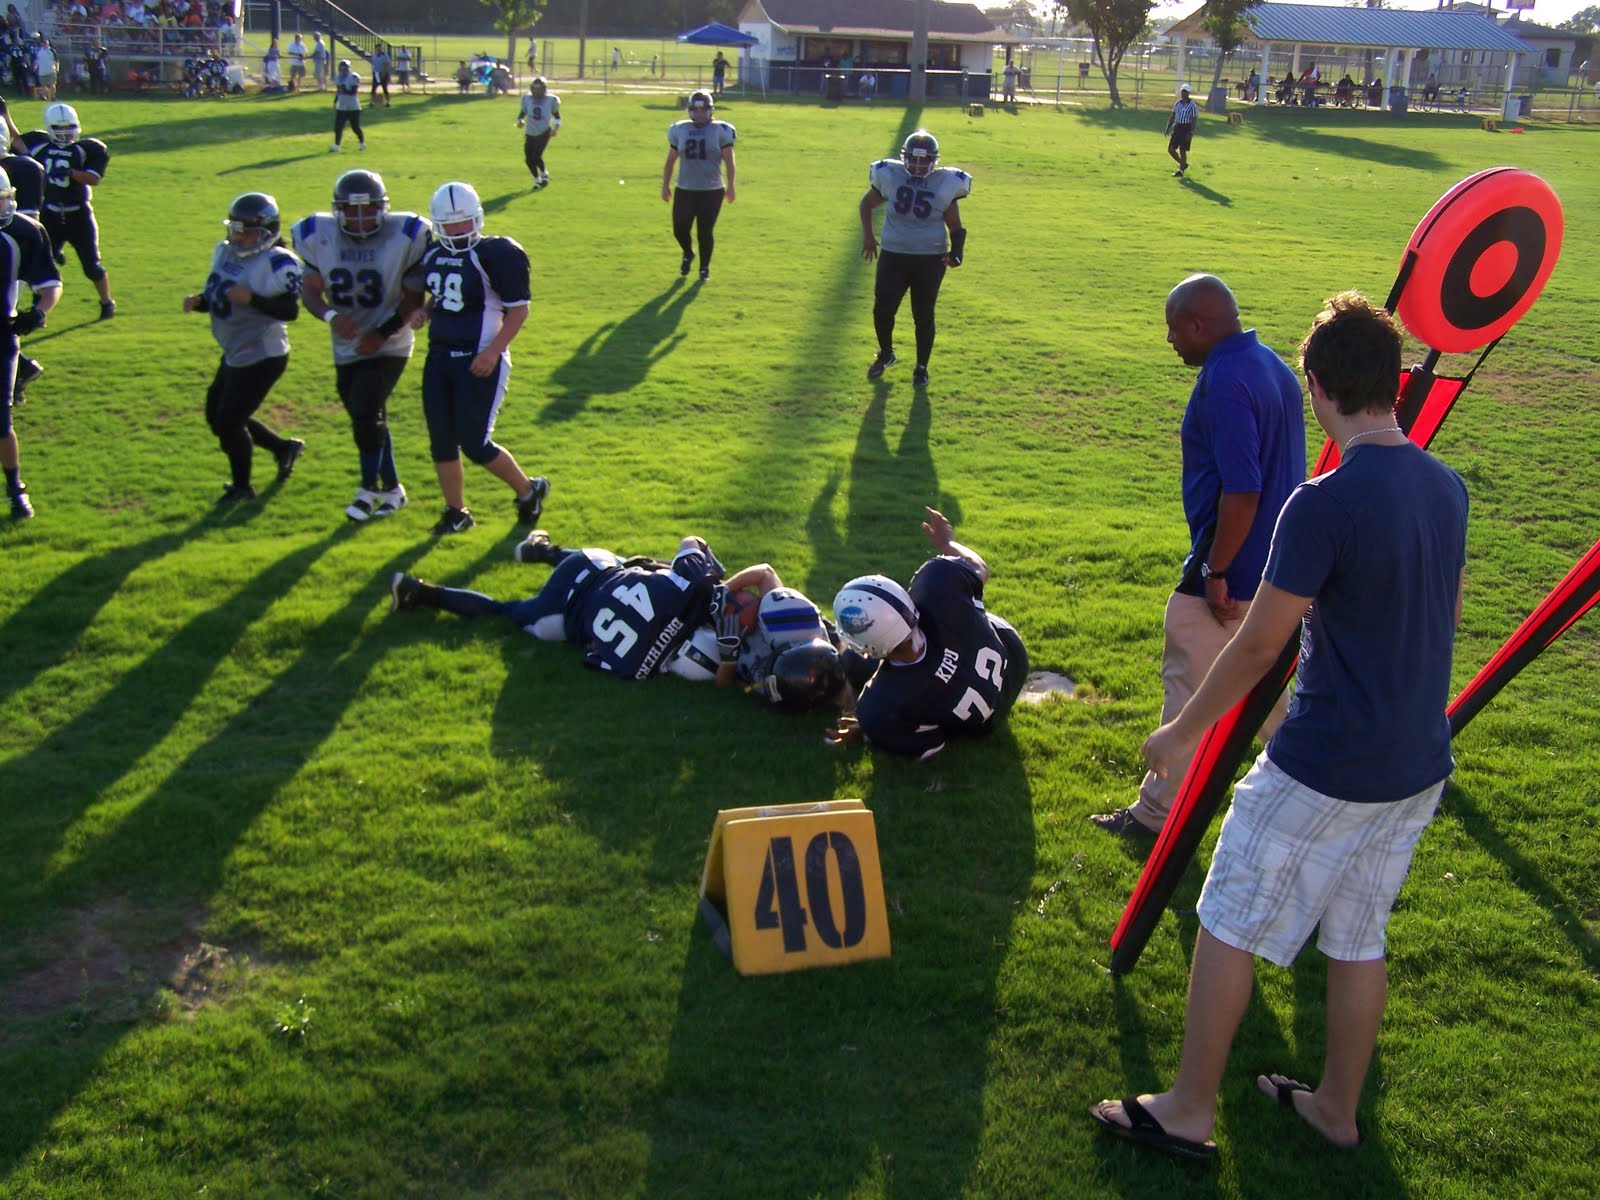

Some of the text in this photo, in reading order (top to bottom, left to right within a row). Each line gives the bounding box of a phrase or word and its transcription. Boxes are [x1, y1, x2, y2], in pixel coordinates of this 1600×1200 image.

[533, 107, 542, 121] 9
[1232, 114, 1242, 124] 10
[685, 138, 706, 160] 21
[894, 185, 935, 219] 95
[328, 267, 383, 309] 23
[592, 581, 656, 659] 45
[934, 647, 960, 684] KIPU
[952, 646, 1003, 723] 72
[754, 831, 867, 953] 40
